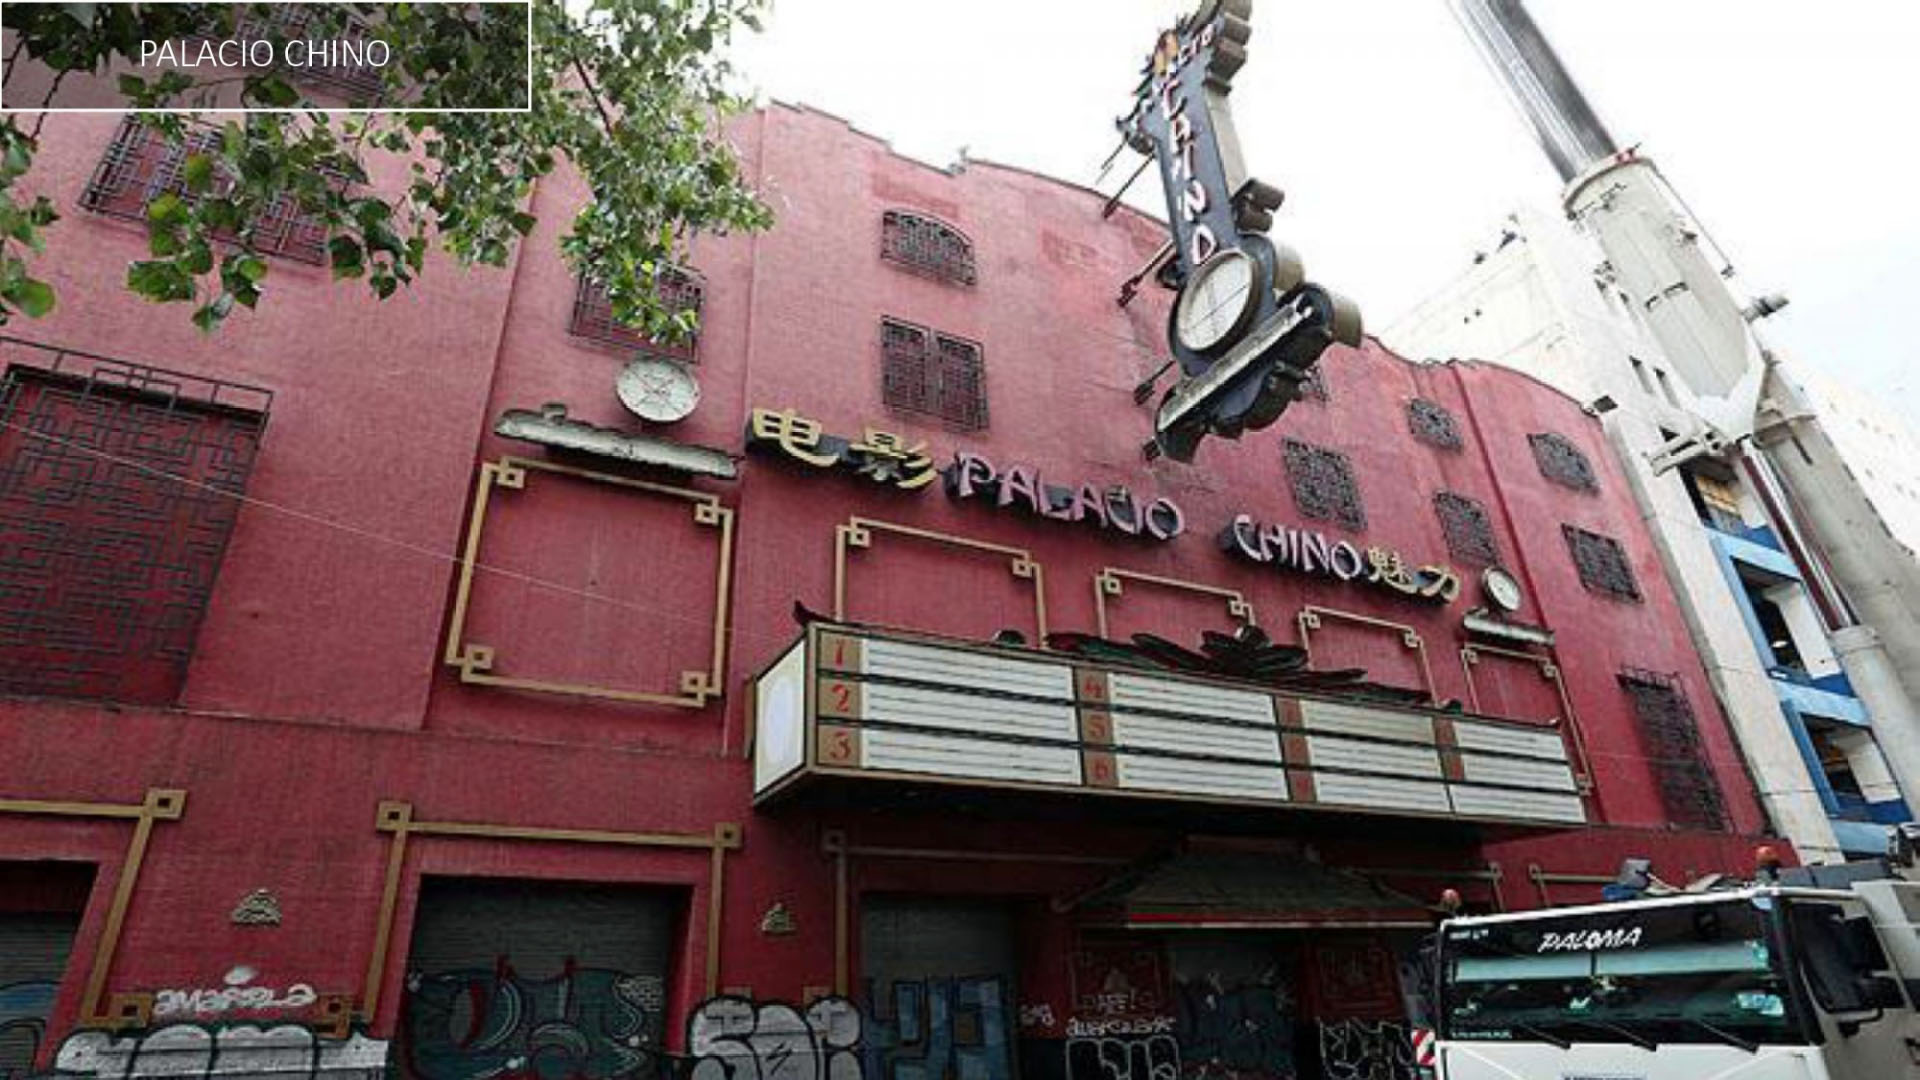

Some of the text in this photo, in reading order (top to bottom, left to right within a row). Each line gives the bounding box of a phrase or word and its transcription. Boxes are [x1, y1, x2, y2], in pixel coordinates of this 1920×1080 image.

[751, 407, 939, 490] 电影
[954, 449, 1363, 580] PALACIO CHINO
[1367, 545, 1460, 601] 魅力
[831, 684, 849, 713] 2
[829, 729, 852, 760] 3
[1537, 926, 1643, 953] PALOMA
